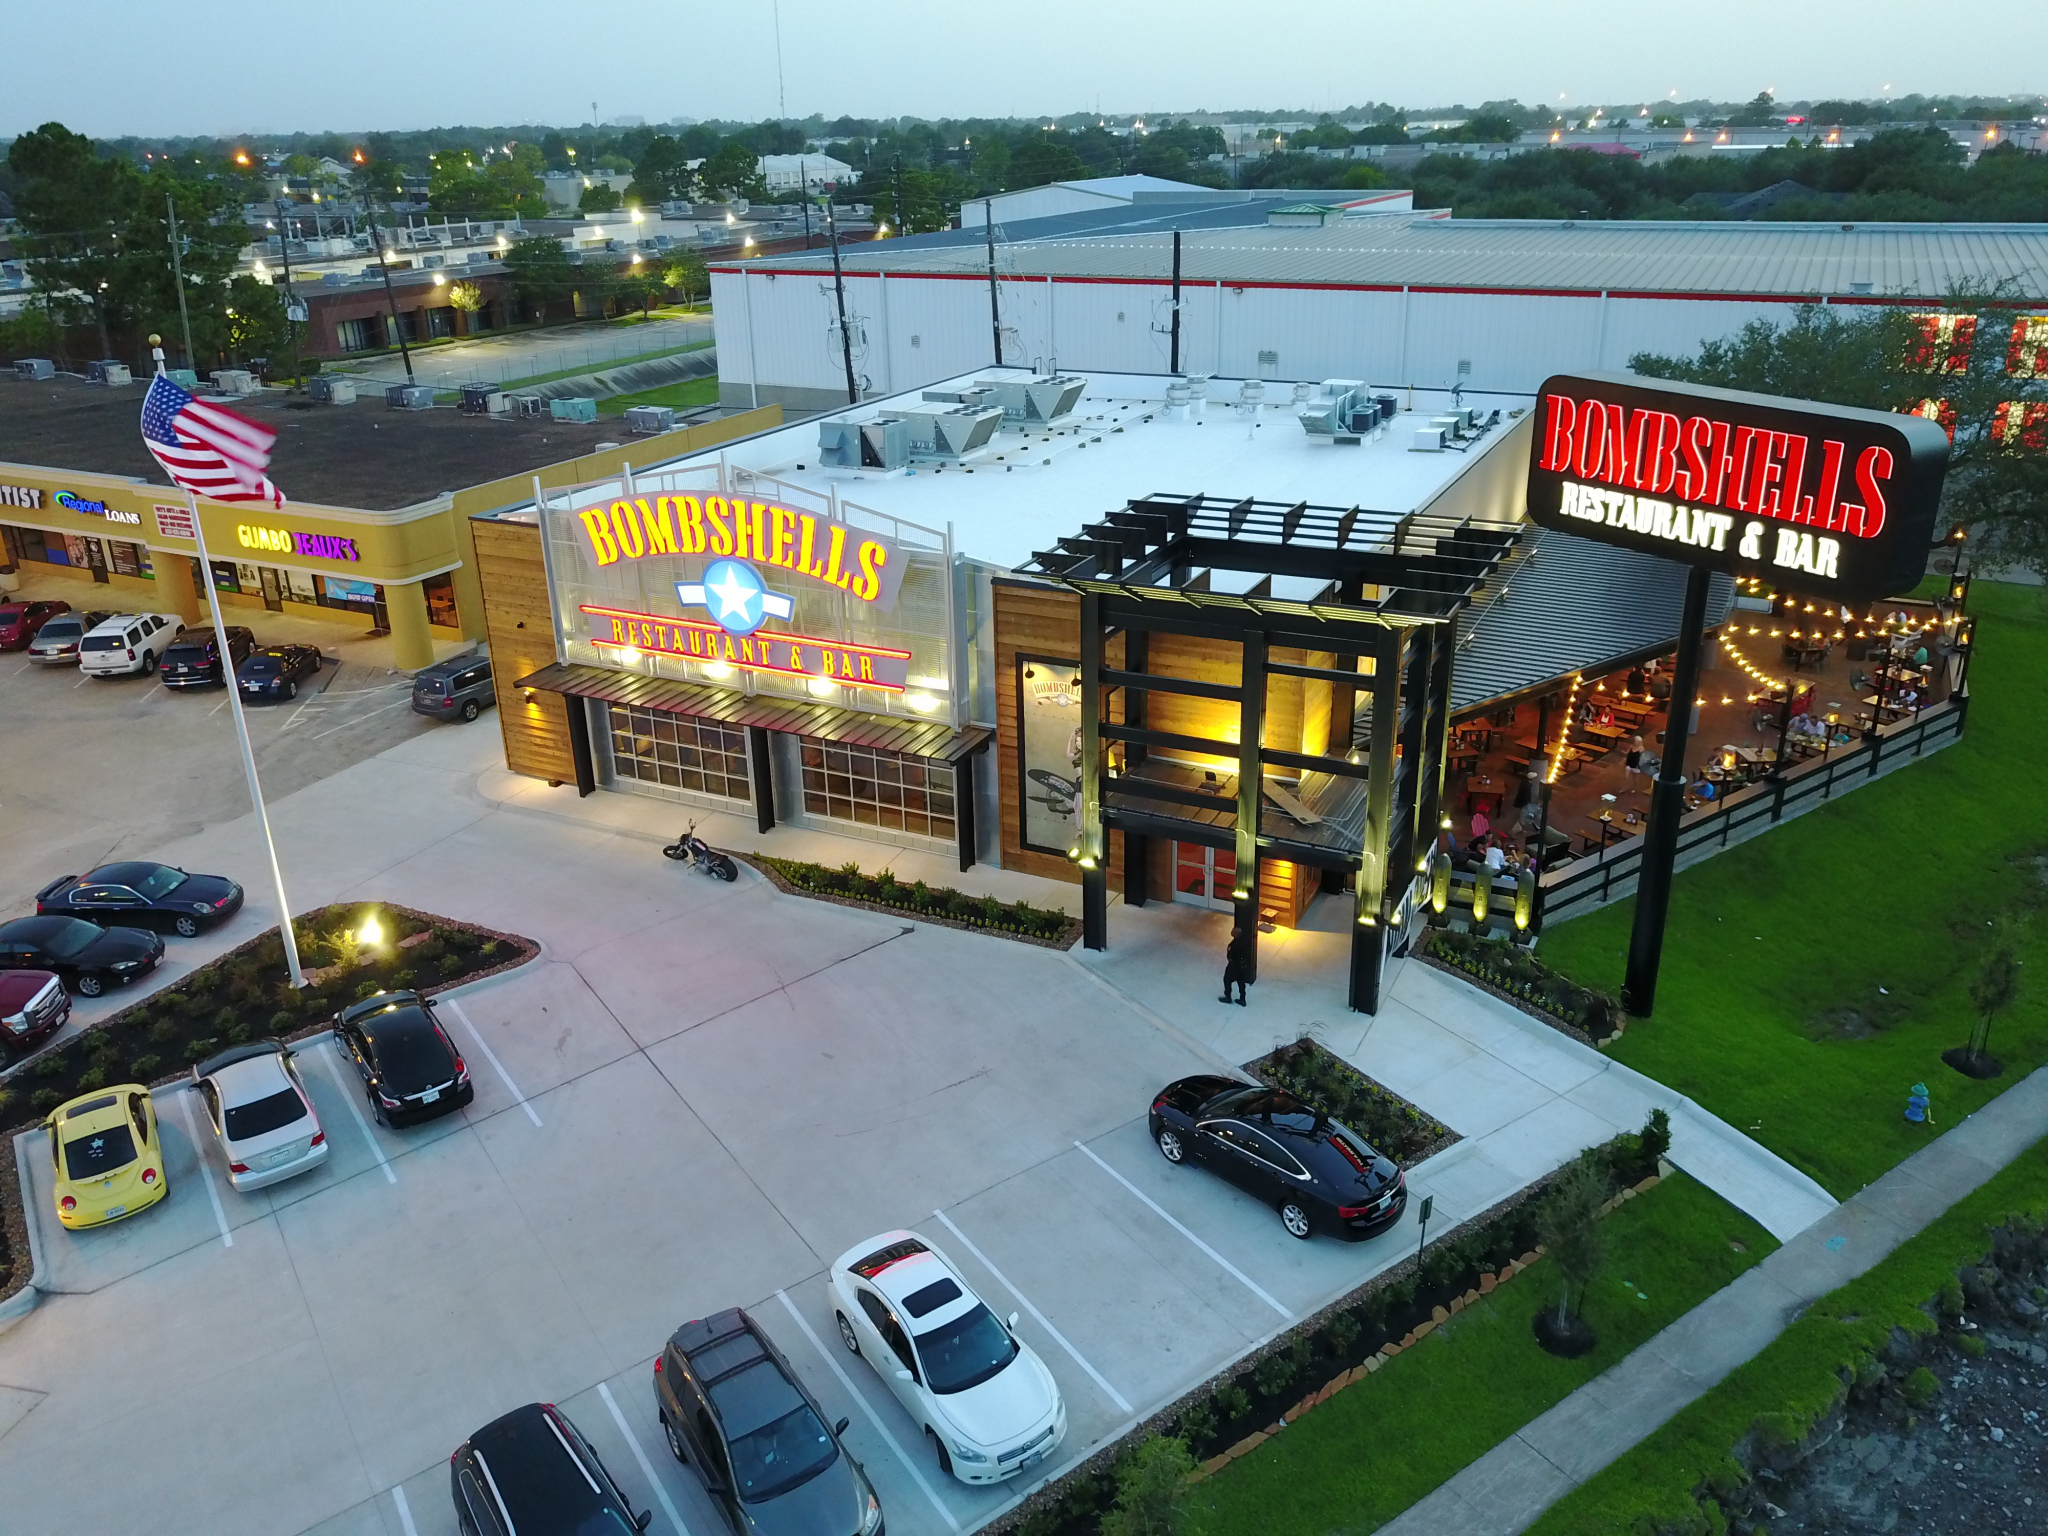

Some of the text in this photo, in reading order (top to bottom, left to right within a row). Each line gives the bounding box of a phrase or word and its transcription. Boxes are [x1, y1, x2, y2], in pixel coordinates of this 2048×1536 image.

[1539, 394, 1894, 539] BOMBSHELLS
[0, 485, 40, 509] TIST
[62, 496, 104, 514] Regional
[104, 509, 141, 525] LOANS
[238, 525, 357, 562] GUMBO JEAUX'S
[579, 496, 888, 602] BOMBSHELLS
[1559, 481, 1840, 579] RESTAURANT & BAR
[612, 619, 876, 682] RESTAURANT & BAR
